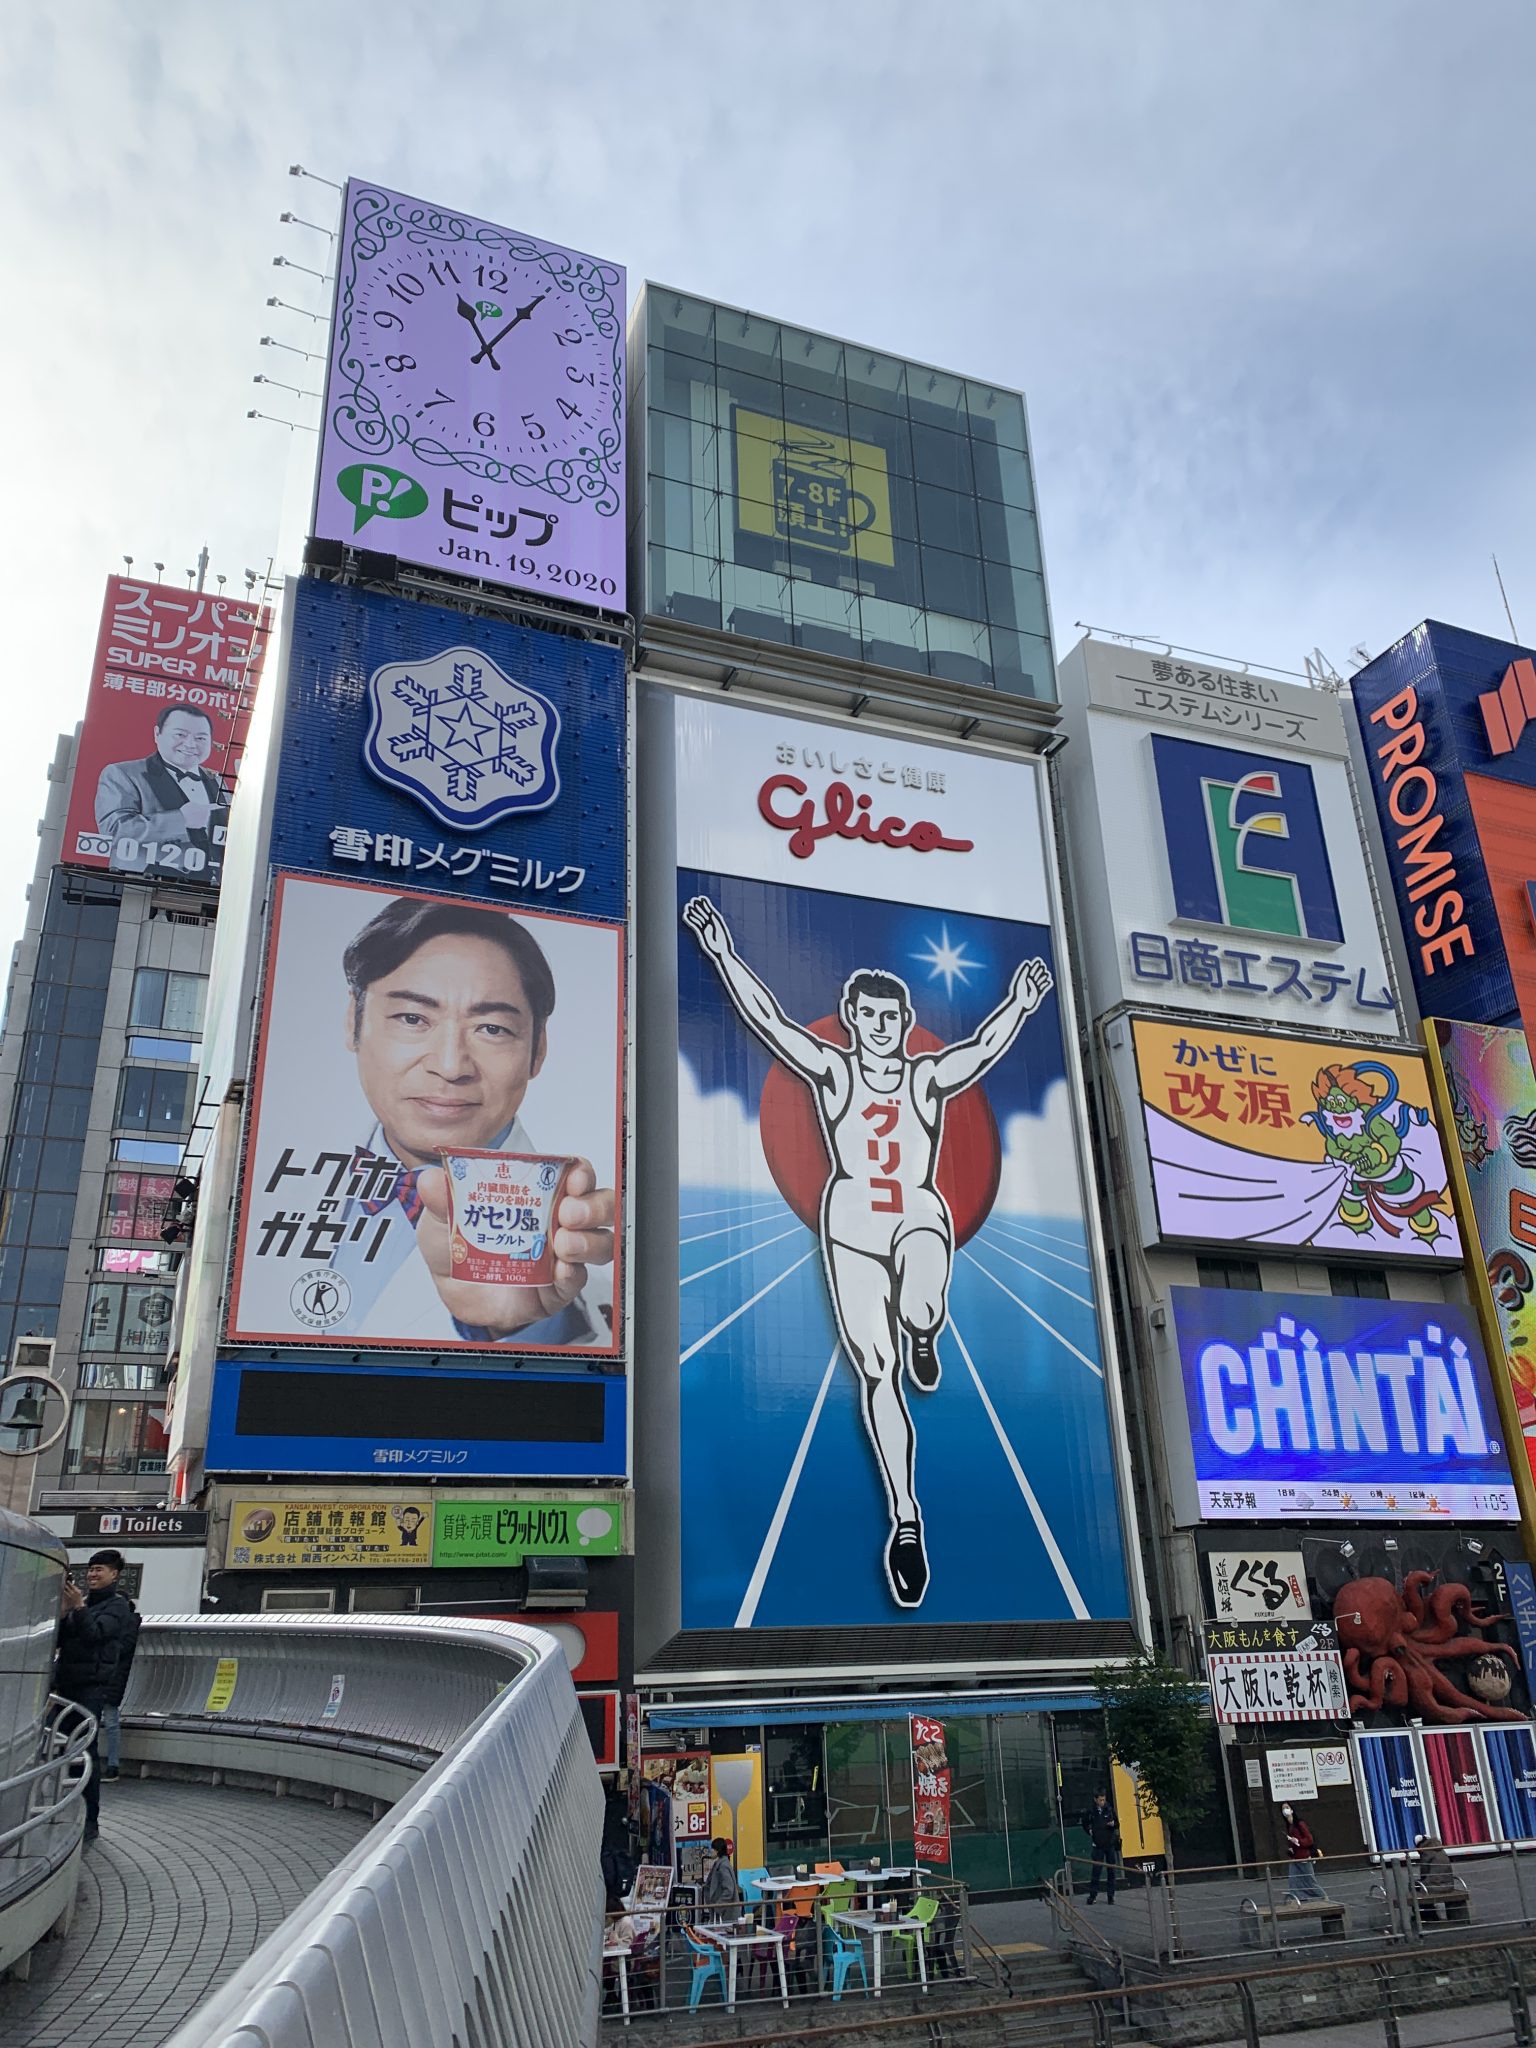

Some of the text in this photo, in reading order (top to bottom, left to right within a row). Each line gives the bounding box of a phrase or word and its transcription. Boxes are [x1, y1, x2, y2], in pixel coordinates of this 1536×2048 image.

[386, 272, 425, 305] 10
[427, 260, 461, 286] 11
[474, 264, 508, 294] 12
[373, 310, 404, 333] 9
[552, 327, 583, 347] 2
[384, 353, 417, 373] 8
[565, 365, 596, 388] 3
[424, 387, 456, 410] 7
[556, 396, 584, 421] 4
[472, 412, 496, 438] 6
[520, 412, 546, 441] 5
[778, 473, 841, 508] 7-8F
[442, 486, 560, 547] ピップ
[438, 537, 617, 597] Jan. 19, 2020
[115, 583, 258, 631] スーパー
[111, 613, 262, 665] ミリオン
[106, 646, 197, 678] SUPER
[103, 672, 255, 712] 薄毛部分のボリ
[1151, 659, 1280, 704] 夢ある住まい
[1133, 687, 1307, 742] エステムシリーズ
[776, 742, 948, 794] おいしさと健康
[758, 774, 975, 859] Glico
[1370, 686, 1475, 977] PROMISE
[328, 825, 585, 893] 雪印メグミルク
[1130, 931, 1397, 1010] 日商エステム
[1172, 1038, 1278, 1077] かぜに
[1164, 1071, 1296, 1129] 改源
[861, 1098, 904, 1214] グリコ
[264, 1147, 401, 1200] トクホ
[477, 1181, 530, 1195] 内臓脂肪を
[317, 1200, 338, 1213] の
[111, 1219, 133, 1236] 5F
[256, 1210, 393, 1263] ガセリ
[477, 1233, 525, 1246] ヨーグルト
[373, 1448, 468, 1464] 雪印メグミルク
[1209, 1491, 1257, 1510] 天気予報
[126, 1516, 183, 1533] Toilets
[284, 1510, 387, 1527] 店舗情報館
[443, 1509, 570, 1544] 賃貸・売買 ピタットハウス
[1230, 1559, 1290, 1610] くくる
[1493, 1562, 1507, 1602] 2F
[1208, 1627, 1299, 1649] 大阪もんを食す
[1319, 1638, 1335, 1650] 2F
[1220, 1663, 1327, 1710] 大阪に乾杯
[915, 1720, 944, 1744] たこ
[918, 1773, 949, 1798] 焼き
[689, 1813, 705, 1831] 8F
